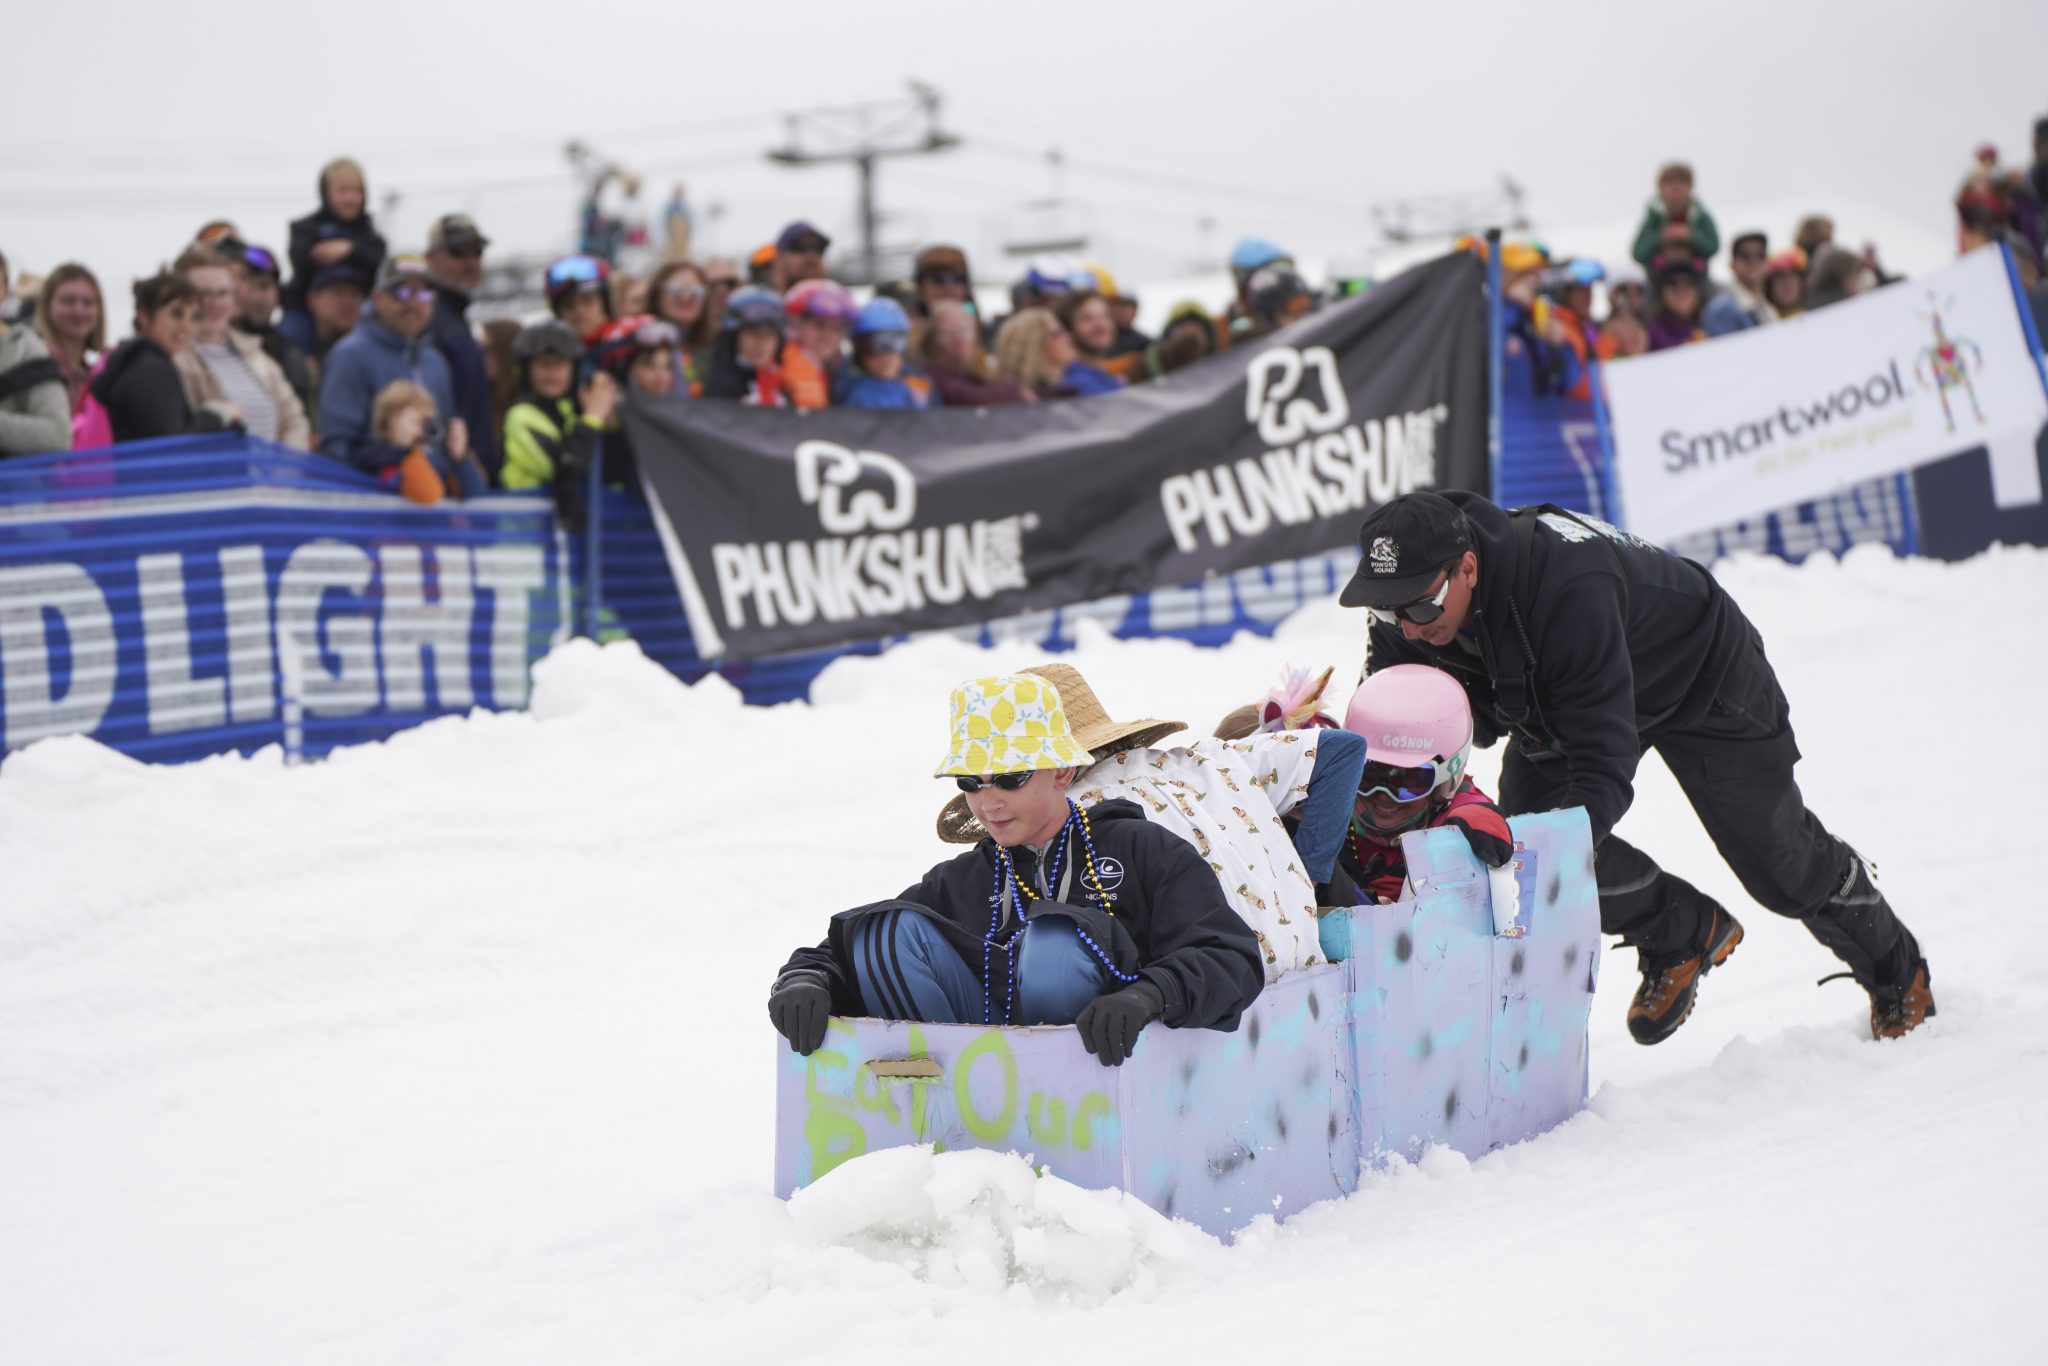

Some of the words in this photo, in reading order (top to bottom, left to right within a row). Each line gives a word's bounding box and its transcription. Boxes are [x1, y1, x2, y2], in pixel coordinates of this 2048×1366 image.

[1659, 360, 1905, 474] Smartwool
[136, 538, 546, 735] LIGHT
[954, 1030, 1111, 1150] Our
